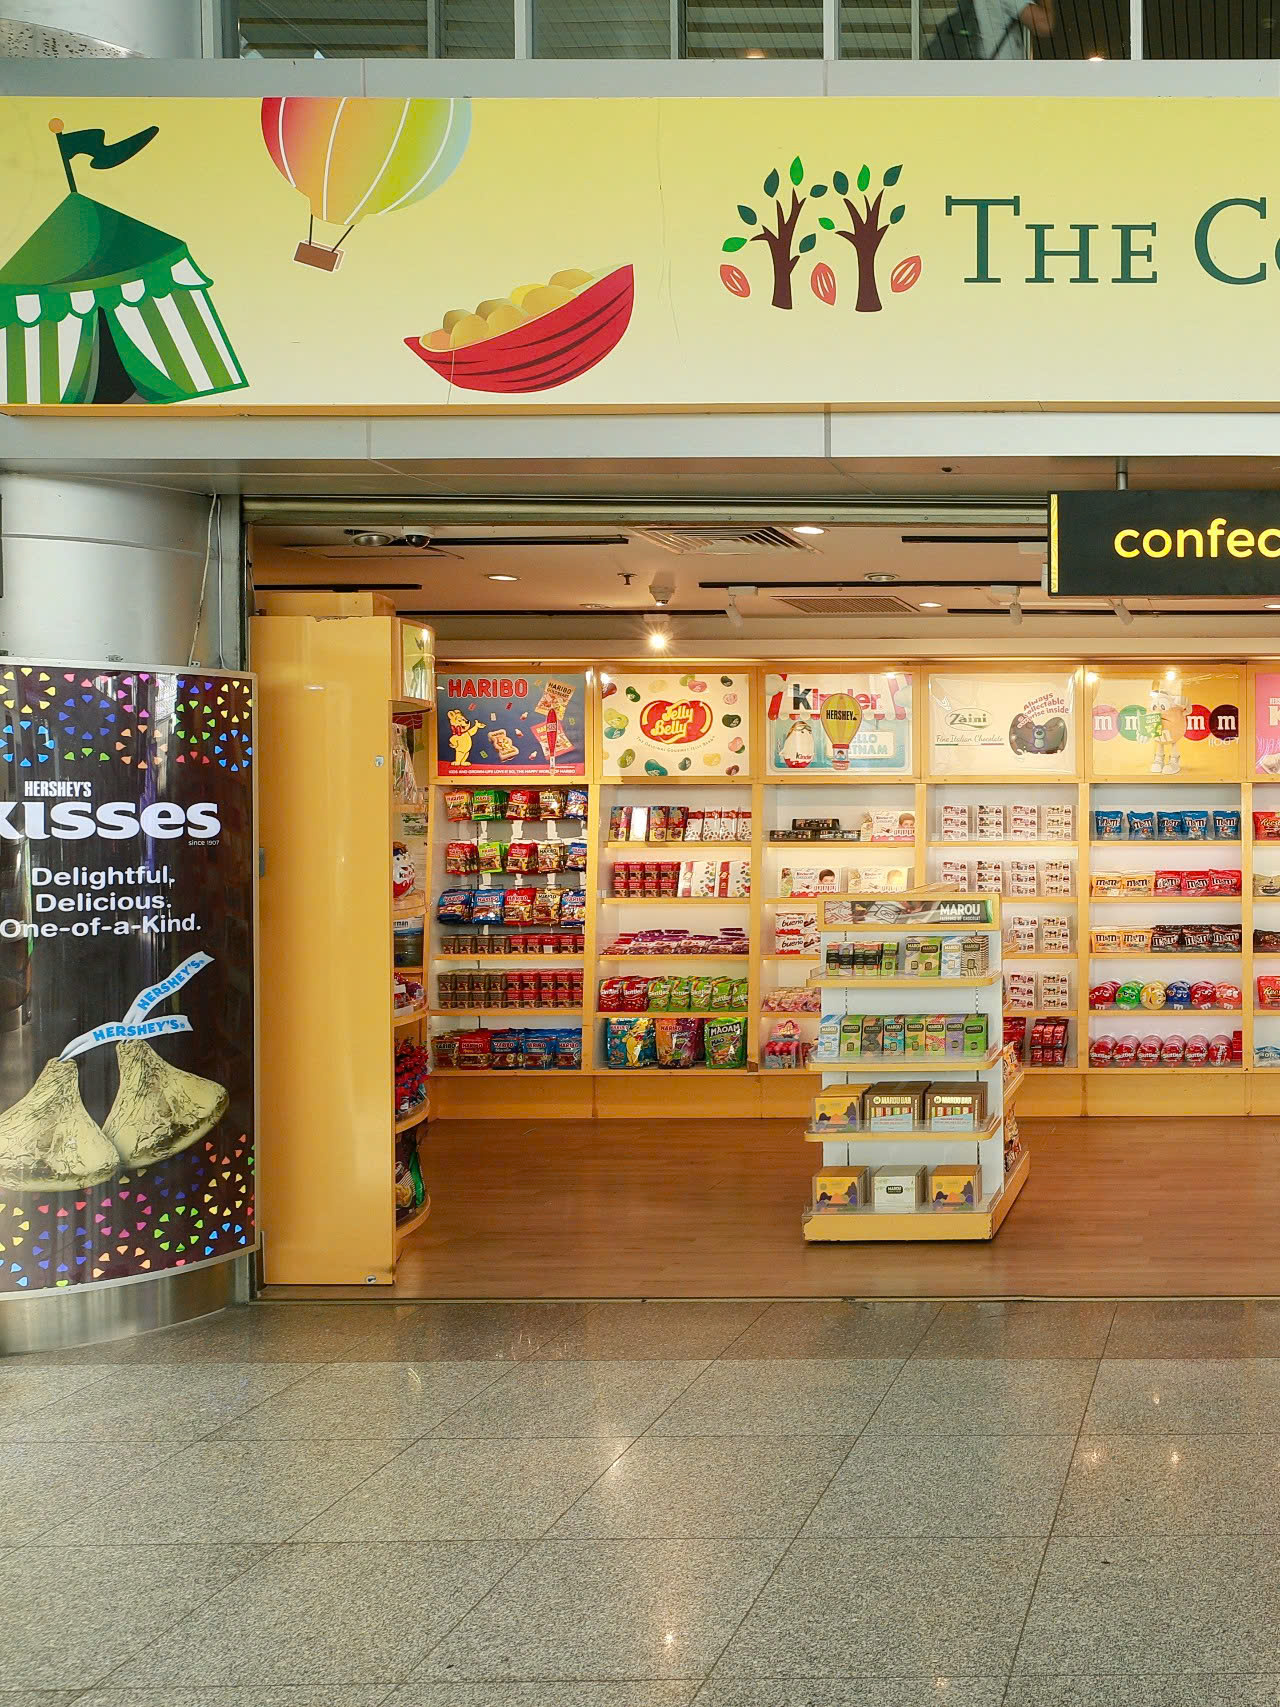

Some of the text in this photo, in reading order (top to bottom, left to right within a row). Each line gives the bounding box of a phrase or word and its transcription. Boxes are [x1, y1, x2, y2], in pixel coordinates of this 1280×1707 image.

[945, 195, 1158, 285] THE
[448, 678, 528, 699] HARIBO
[1023, 692, 1054, 711] Always
[662, 705, 694, 723] Jelly
[1046, 706, 1070, 715] inside
[651, 719, 688, 738] Belly
[1094, 714, 1113, 731] m
[1186, 714, 1206, 731] m
[1217, 714, 1237, 731] m
[974, 734, 1004, 743] Chocolate
[24, 781, 92, 797] HERSHEY'S
[940, 904, 981, 915] MAROU
[0, 913, 202, 938] One-of-a-Kind.
[782, 919, 804, 928] bueno
[782, 940, 804, 948] bueno
[137, 958, 201, 1011] HERSHEY'S
[92, 1019, 181, 1042] HERSHEY'S
[710, 1024, 741, 1036] MAOAM
[880, 1096, 912, 1105] MAROU BAR
